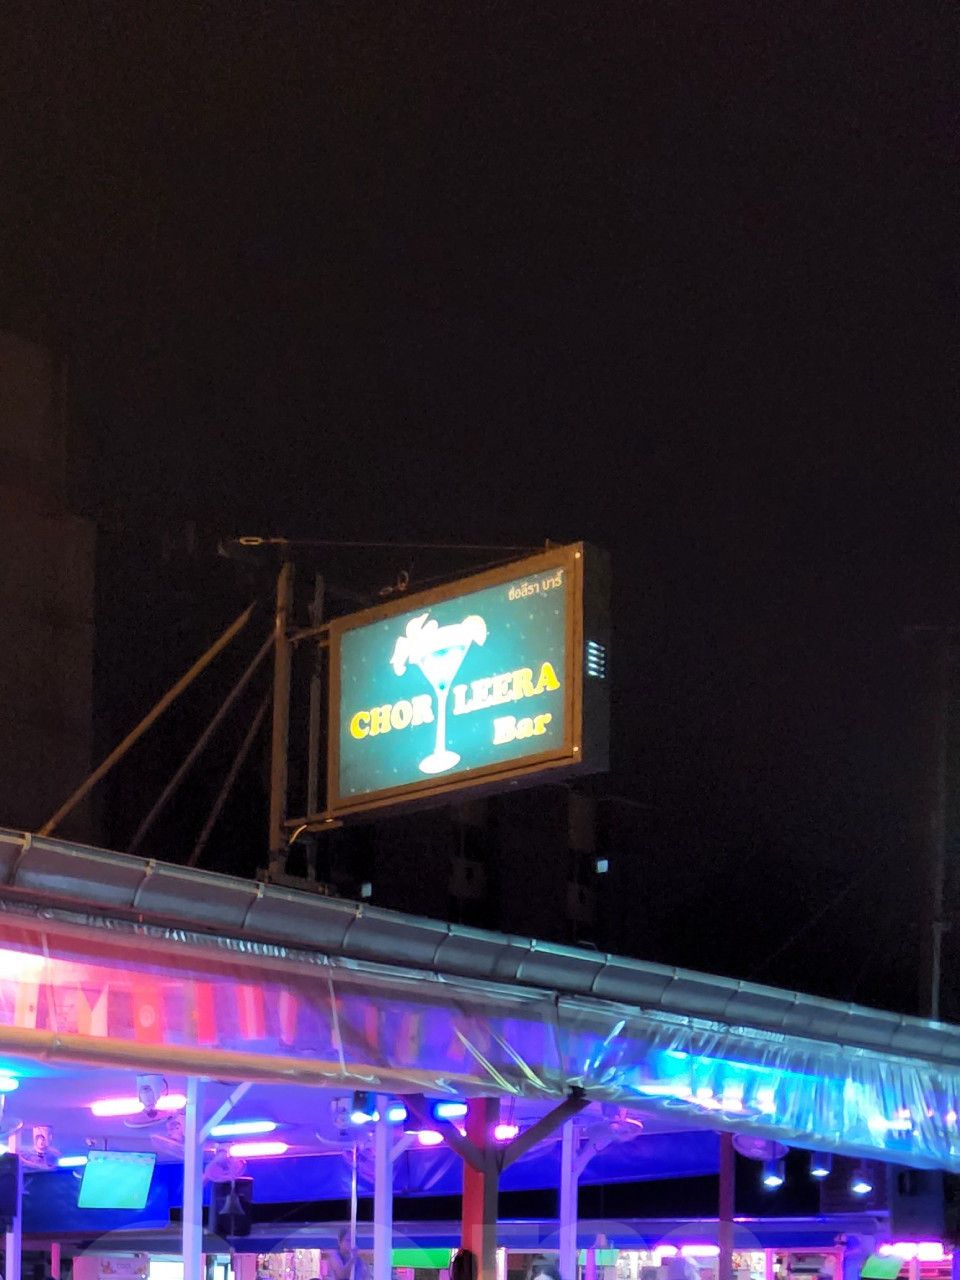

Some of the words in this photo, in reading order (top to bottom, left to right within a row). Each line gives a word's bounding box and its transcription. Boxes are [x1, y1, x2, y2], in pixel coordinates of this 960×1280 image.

[542, 567, 564, 591] บาร์
[350, 693, 435, 740] CHOR
[453, 662, 561, 716] LEERA
[492, 713, 552, 745] Bar
